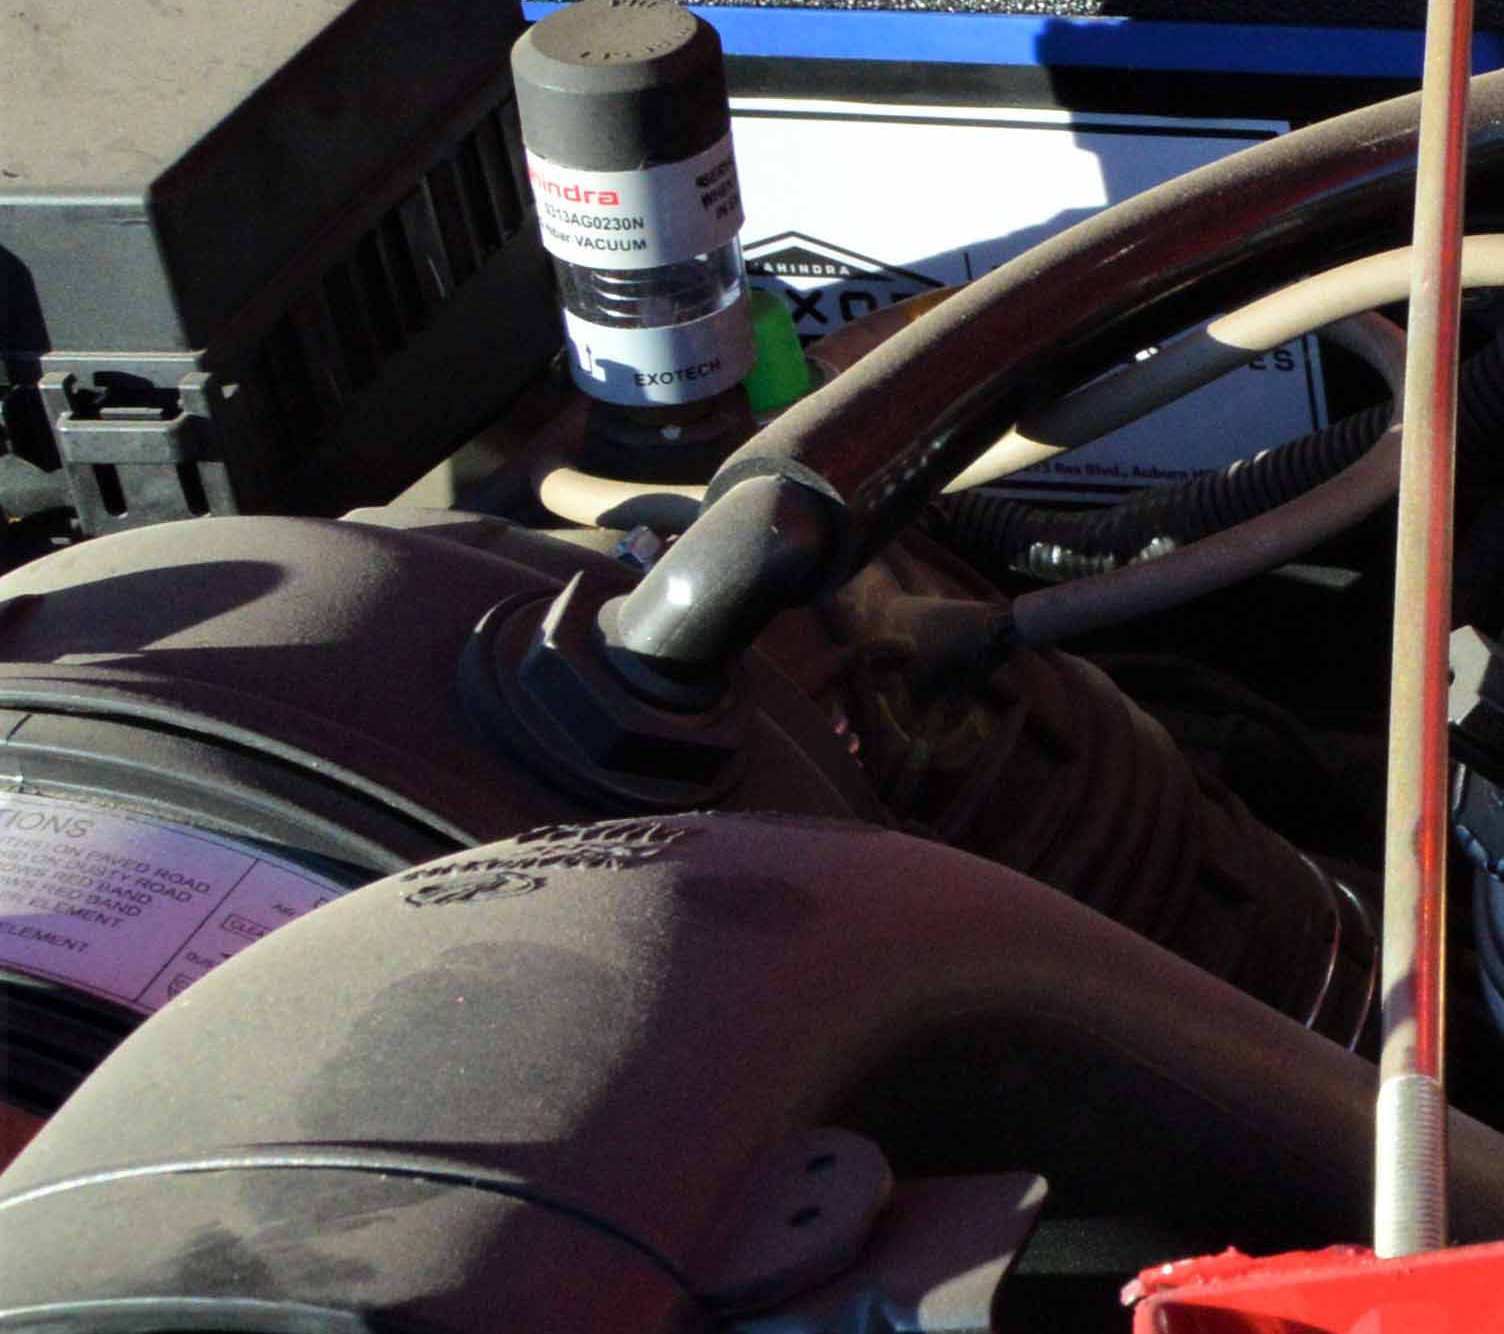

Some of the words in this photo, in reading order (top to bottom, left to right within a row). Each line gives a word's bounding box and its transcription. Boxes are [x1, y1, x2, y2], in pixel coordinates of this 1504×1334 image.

[575, 235, 647, 252] VACUUM
[633, 356, 722, 387] EXOTECH
[86, 894, 142, 917] BAND
[96, 882, 153, 906] BAND
